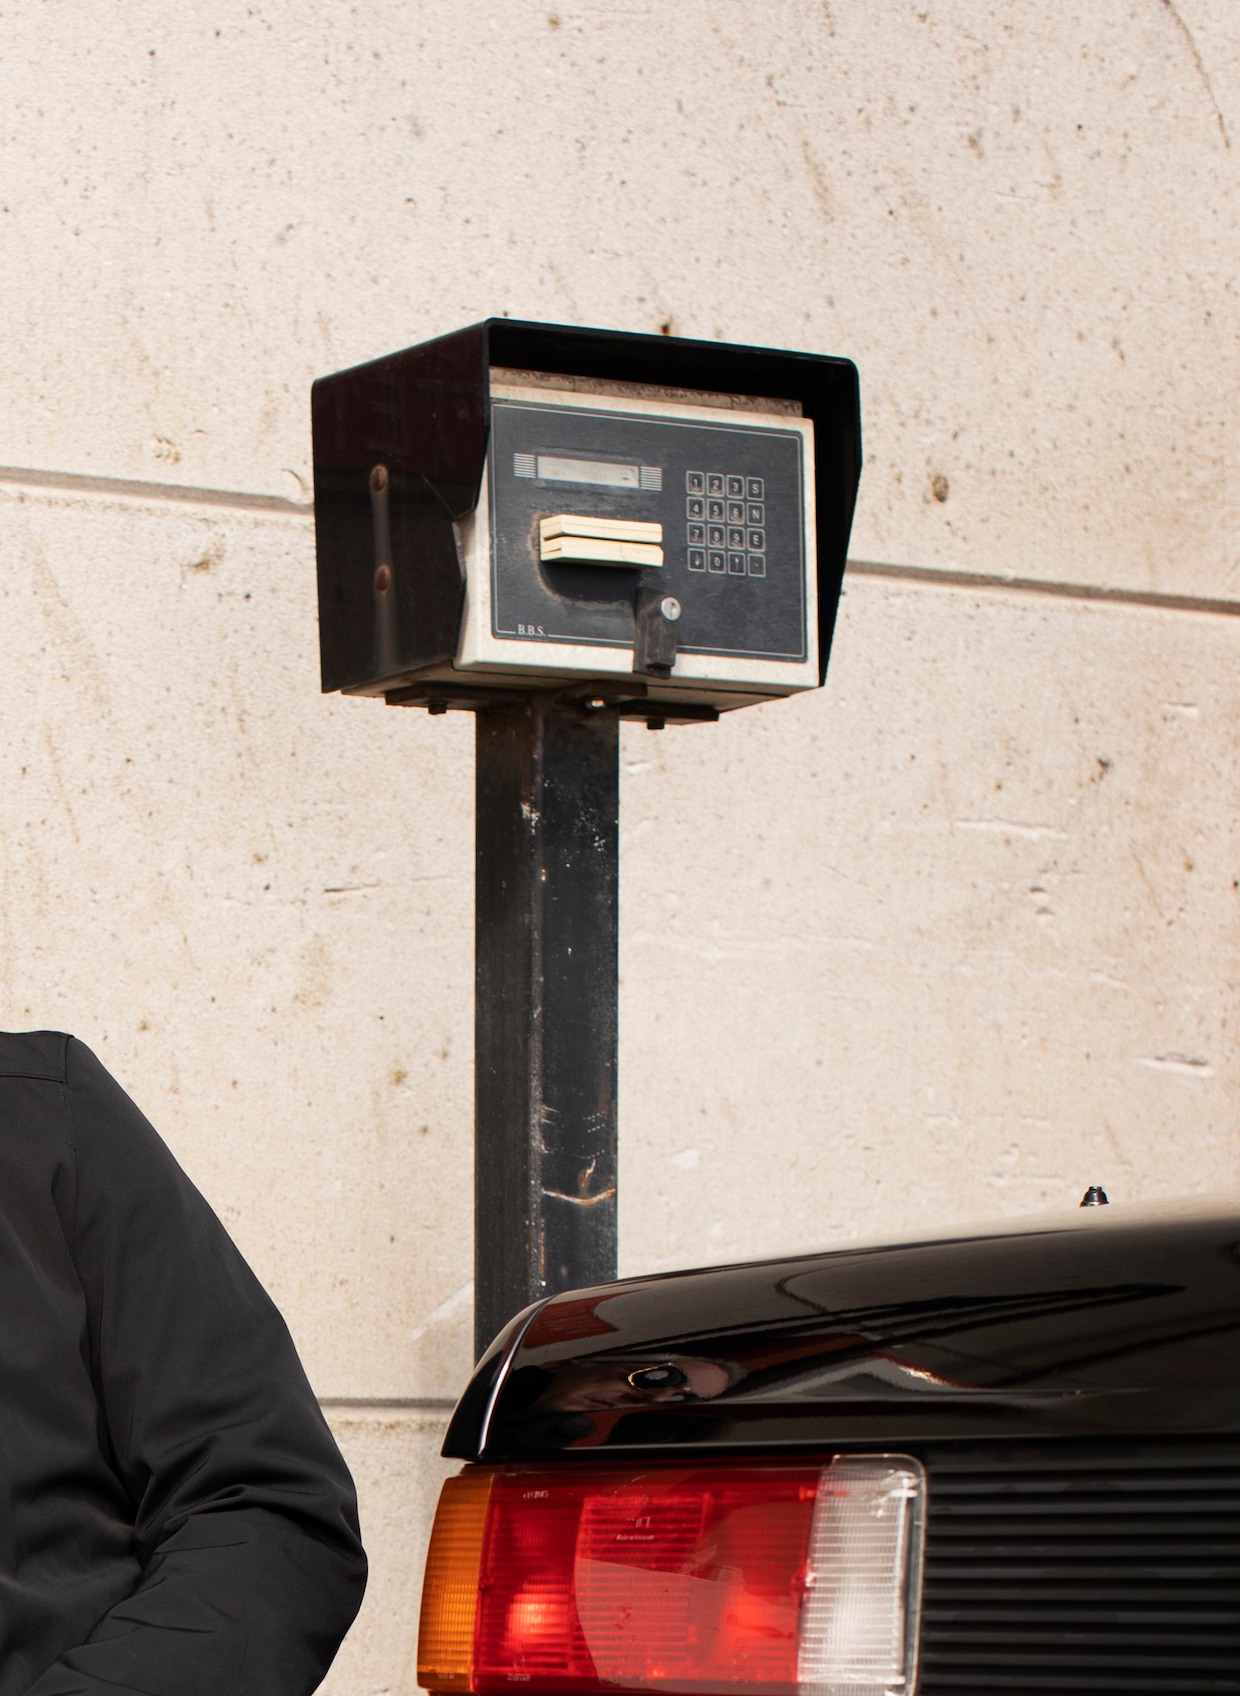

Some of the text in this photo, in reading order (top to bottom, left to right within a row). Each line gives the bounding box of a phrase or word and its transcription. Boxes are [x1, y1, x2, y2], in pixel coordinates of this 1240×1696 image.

[732, 481, 739, 493] 3
[751, 483, 760, 495] S
[751, 508, 760, 520] N
